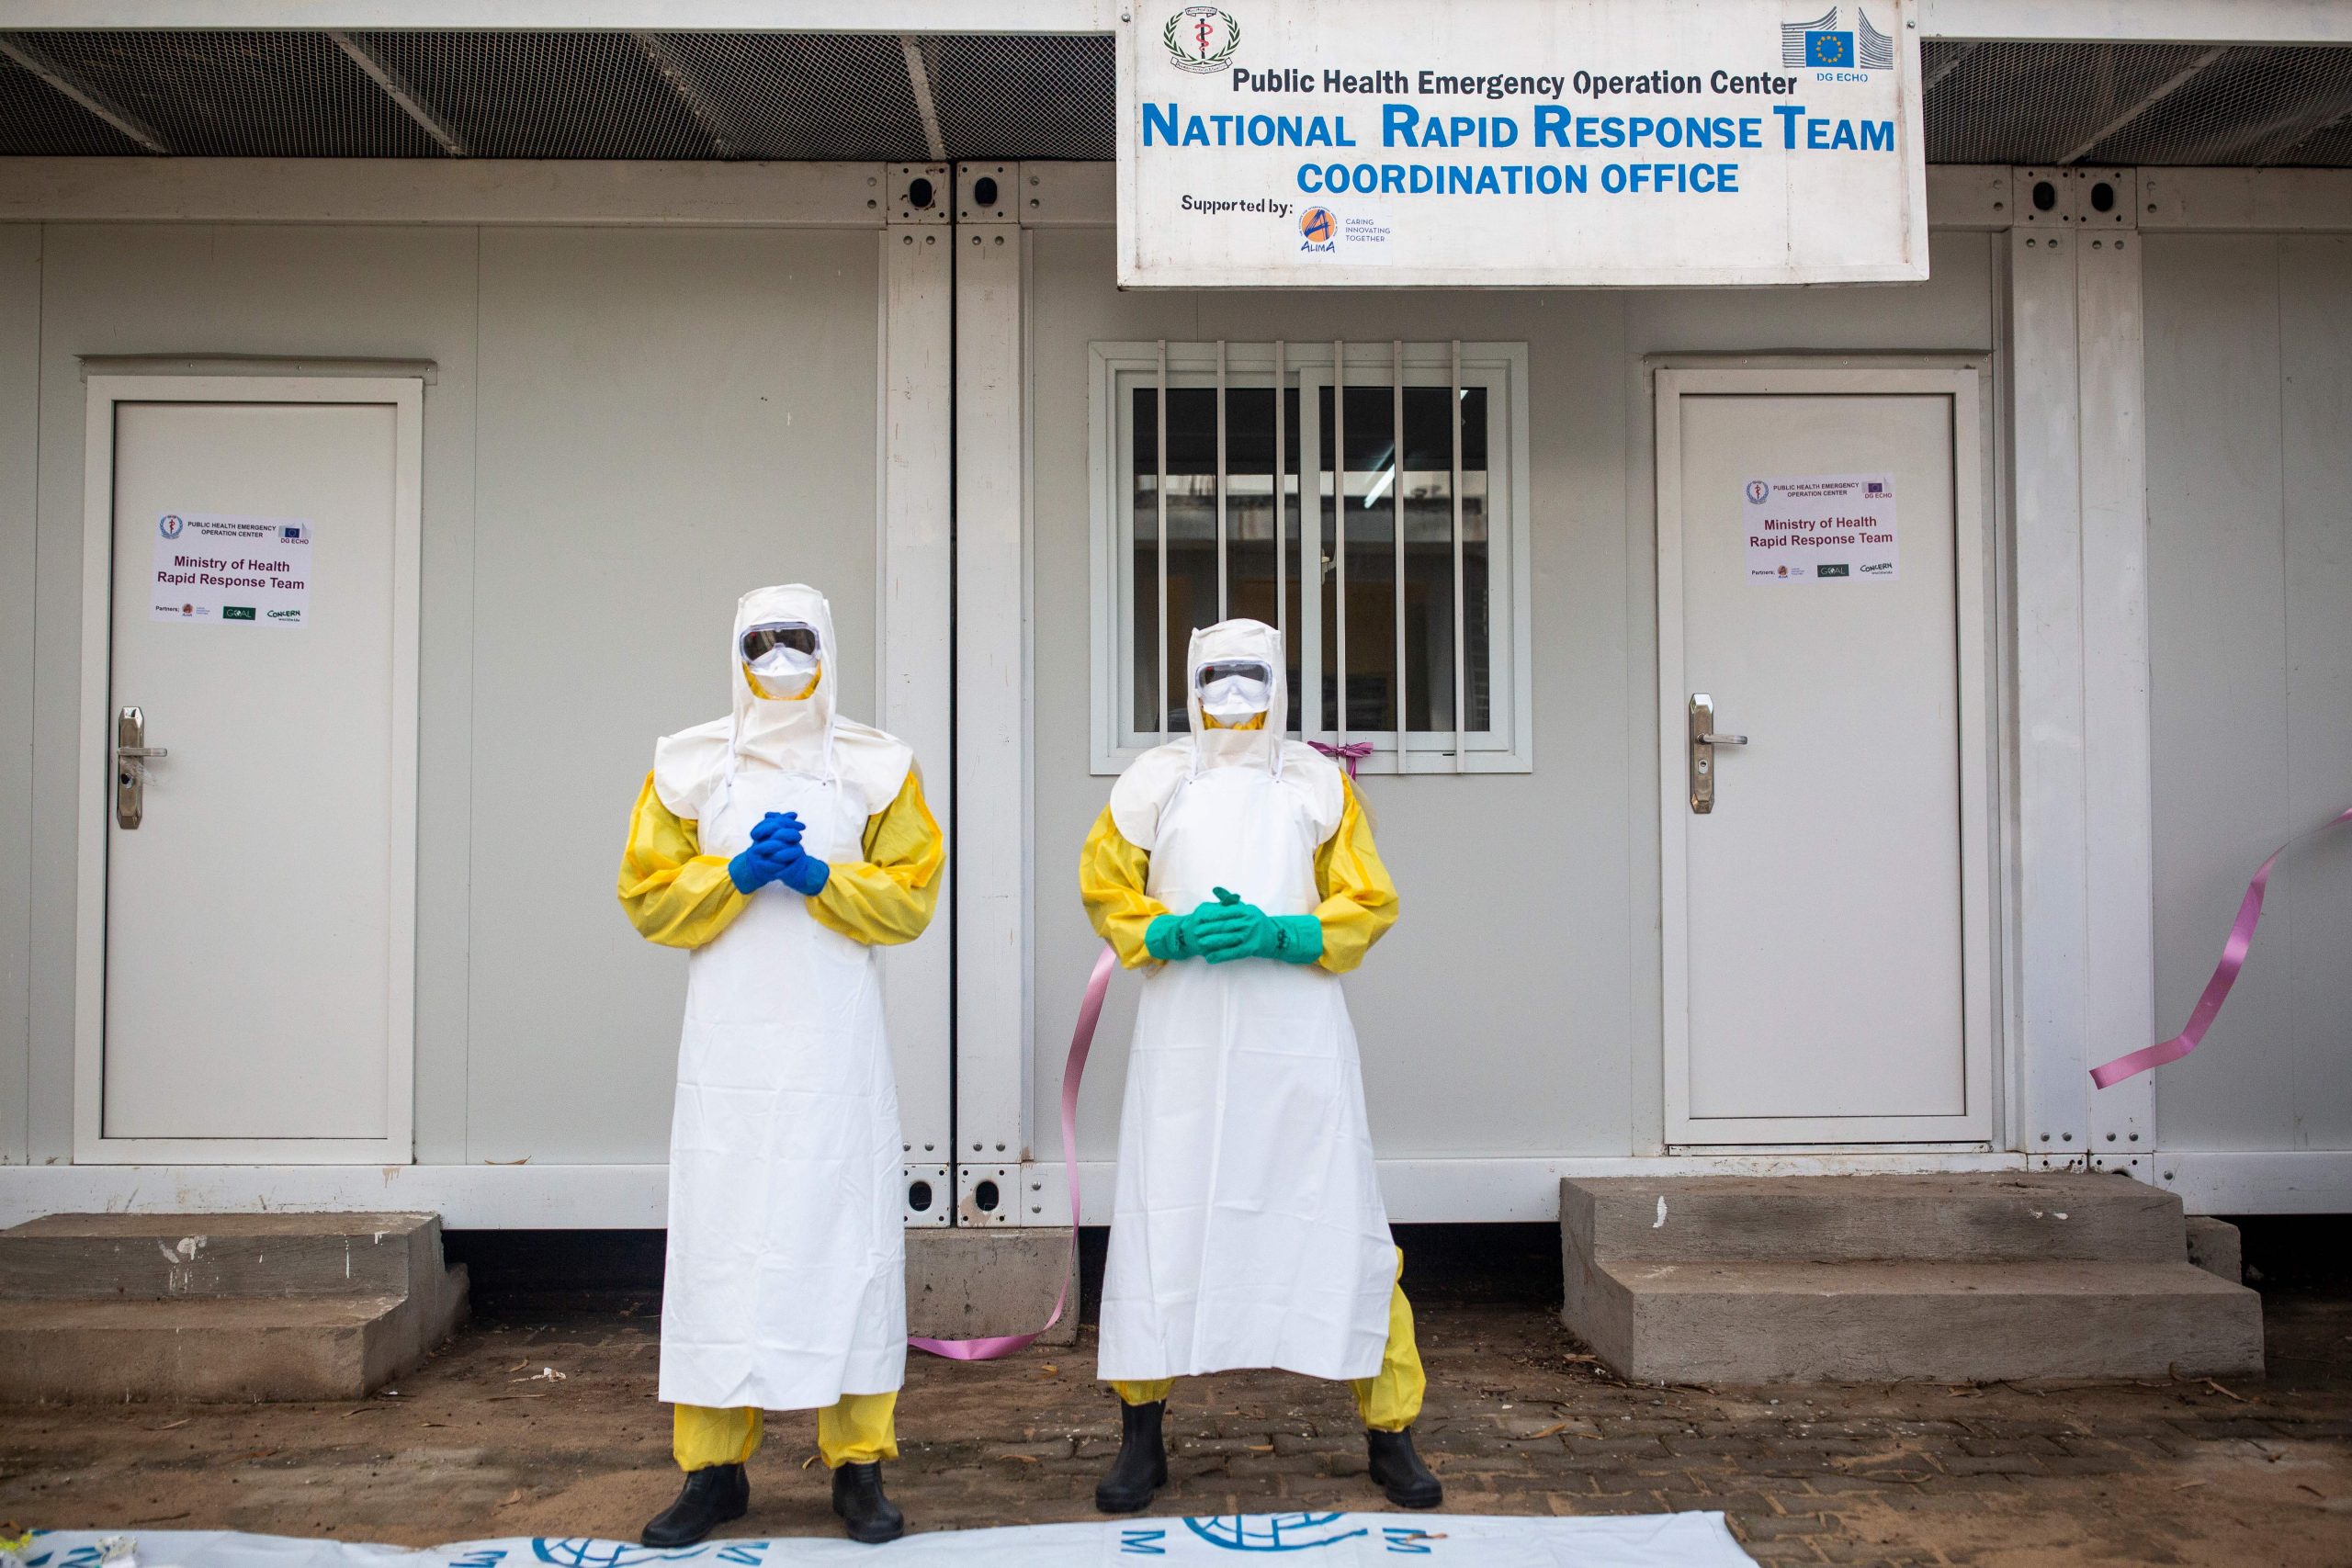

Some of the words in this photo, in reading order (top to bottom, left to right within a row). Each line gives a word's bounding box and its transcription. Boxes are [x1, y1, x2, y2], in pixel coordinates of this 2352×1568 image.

[1233, 68, 1315, 94] Public
[1324, 70, 1408, 95] Health
[1419, 70, 1565, 100] Emergency
[1573, 70, 1702, 99] Operation
[1710, 70, 1797, 96] Center
[1816, 73, 1834, 83] DG
[1837, 73, 1869, 83] ECHO
[1142, 103, 1356, 147] NATIONAL
[1382, 104, 1519, 148] RAPID
[1534, 105, 1763, 149] RESPONSE
[1773, 106, 1894, 152] TEAM
[1296, 163, 1588, 195] COORDINATION
[1600, 164, 1739, 193] OFFICE
[1181, 194, 1265, 215] Supported
[1269, 198, 1294, 219] by:
[1345, 234, 1385, 243] TOGETHER
[1300, 240, 1336, 254] ALIMA
[237, 524, 277, 532] EMERGENCY
[1764, 518, 1815, 532] Ministry
[1819, 517, 1834, 528] of
[1837, 516, 1877, 528] Health
[1749, 536, 1787, 549] Rapid
[1791, 534, 1855, 547] Response
[1859, 532, 1893, 544] Team
[175, 556, 227, 571] Ministry
[231, 558, 245, 570] of
[248, 559, 290, 572] Health
[157, 571, 196, 586] Rapid
[199, 573, 266, 589] Response
[270, 577, 305, 590] Team
